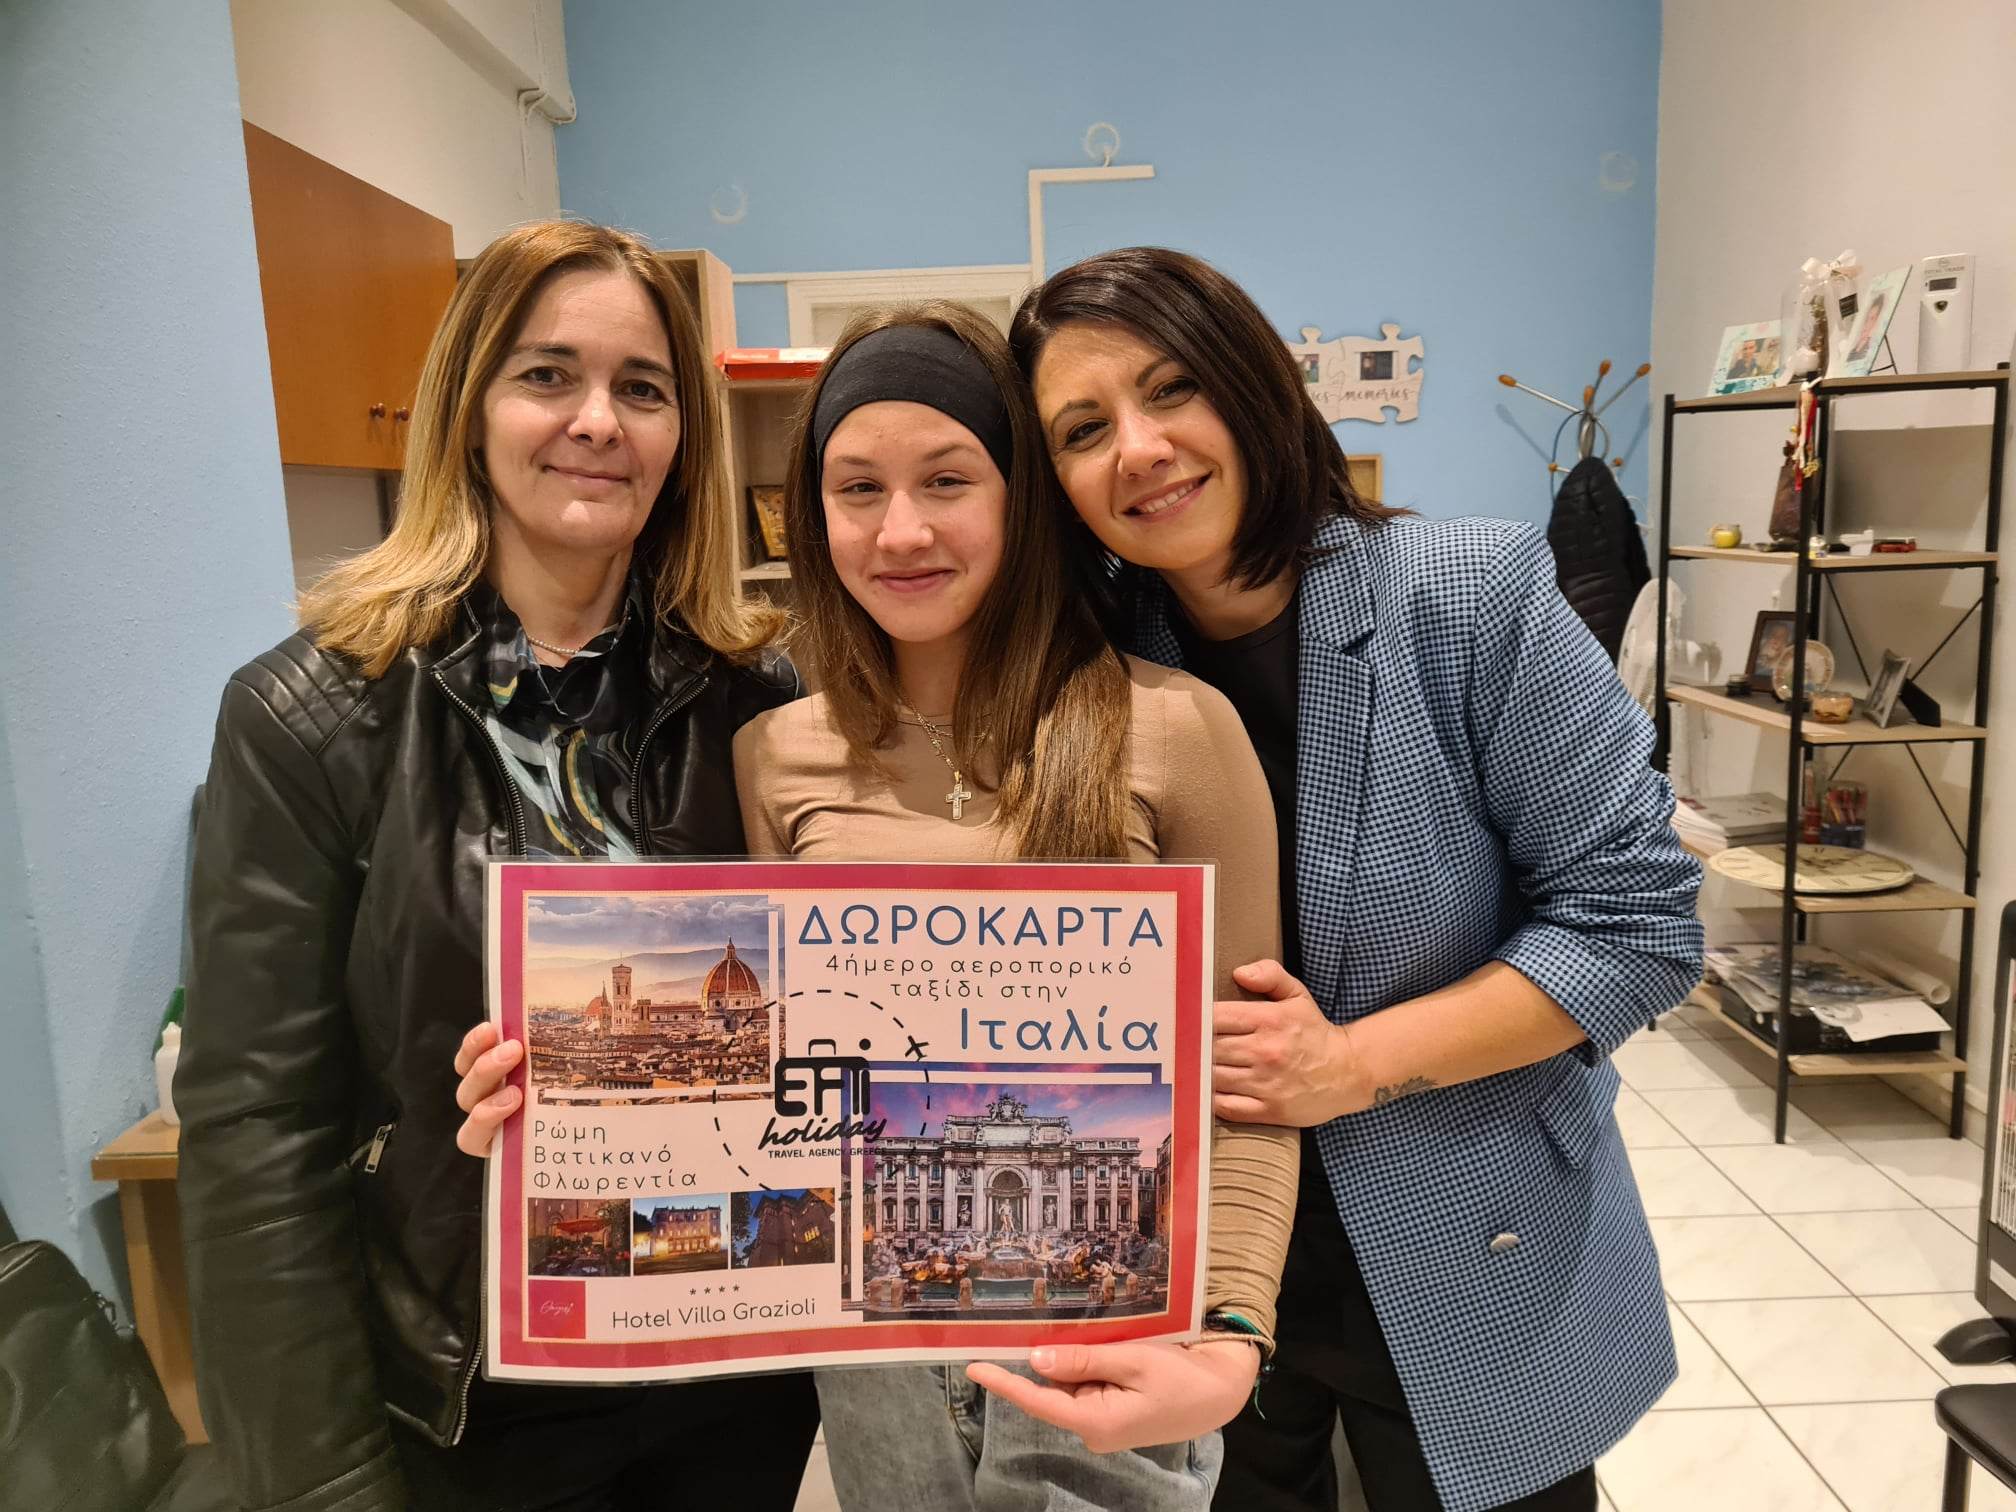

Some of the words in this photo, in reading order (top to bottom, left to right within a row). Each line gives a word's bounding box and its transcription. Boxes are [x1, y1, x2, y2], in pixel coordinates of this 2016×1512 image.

[798, 904, 1163, 948] ΔΩΡΟΚΑΡΤΑ
[826, 953, 934, 977] 4ήμερο
[950, 955, 1132, 978] αεροπορικό
[890, 980, 984, 1001] ταξίδι
[1000, 983, 1068, 1003] στην
[961, 1005, 1159, 1051] Ιταλία
[535, 1120, 606, 1144] Ρώμη
[758, 1115, 888, 1150] holiday
[534, 1144, 671, 1165] Βατικανό
[768, 1149, 805, 1159] TRAVEL
[808, 1148, 848, 1157] AGENCY
[533, 1169, 697, 1195] Φλωρεντία
[612, 1308, 671, 1329] Hotel
[678, 1306, 726, 1325] Villa
[733, 1298, 816, 1320] Grazioli
